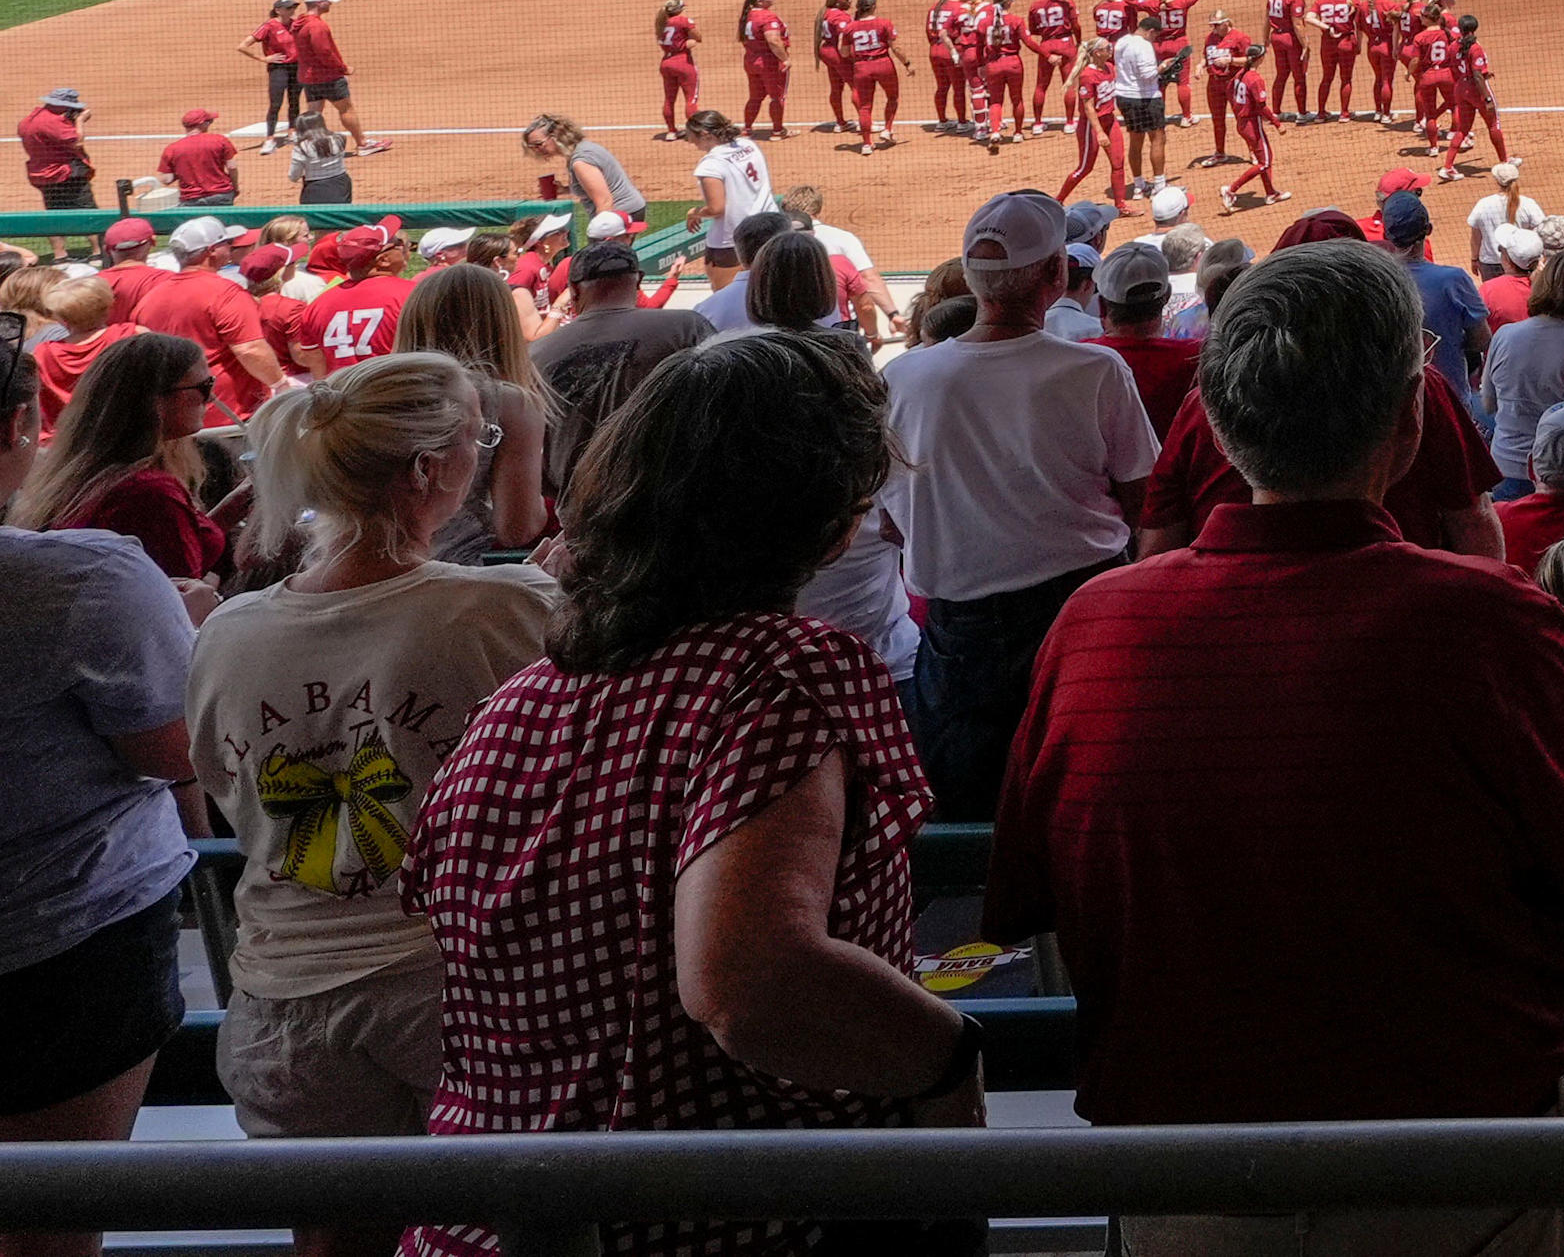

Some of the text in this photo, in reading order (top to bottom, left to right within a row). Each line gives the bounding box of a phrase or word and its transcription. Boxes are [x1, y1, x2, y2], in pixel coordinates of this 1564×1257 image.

[1036, 6, 1065, 29] 12
[1319, 3, 1350, 24] 23
[851, 29, 882, 51] 21
[1430, 40, 1446, 62] 6
[745, 161, 759, 182] 4
[323, 307, 385, 359] 47
[937, 956, 996, 972] BAMA
